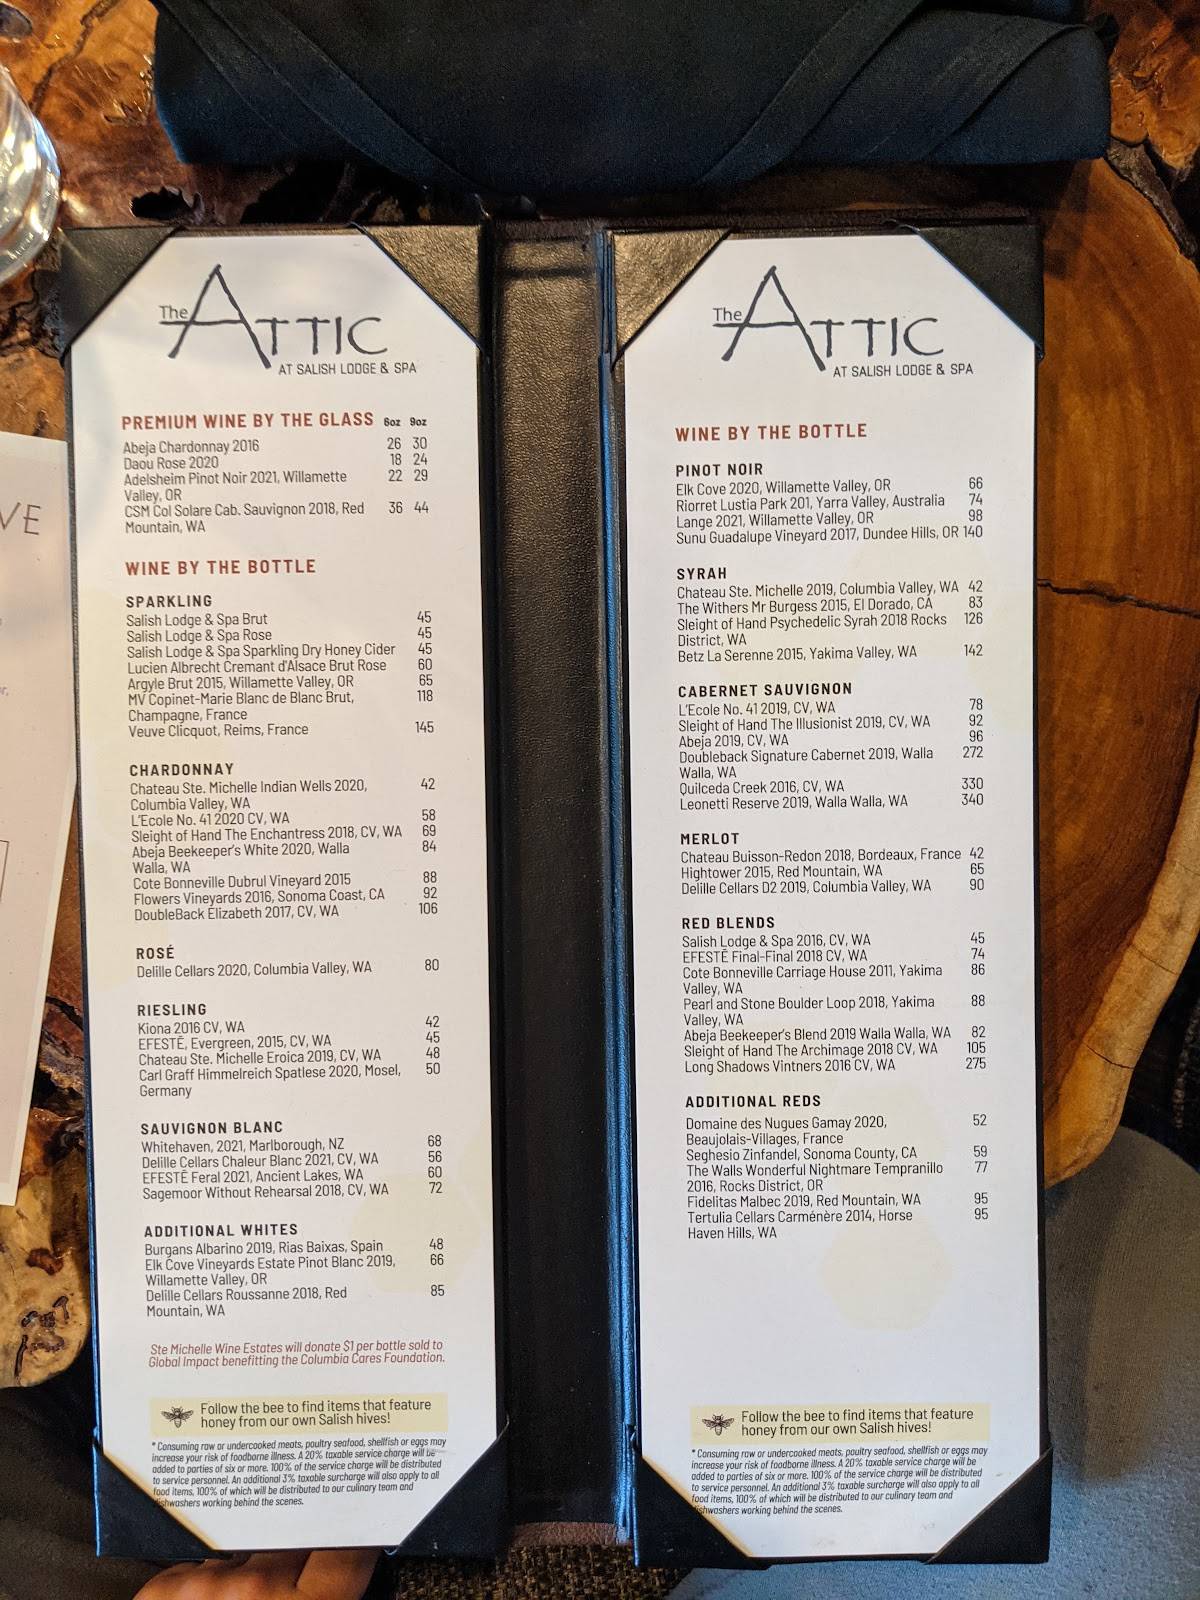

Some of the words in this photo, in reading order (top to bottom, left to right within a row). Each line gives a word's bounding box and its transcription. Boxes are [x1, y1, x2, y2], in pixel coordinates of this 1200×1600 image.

[159, 305, 188, 320] The
[713, 307, 742, 321] The
[278, 363, 293, 375] AT
[296, 362, 336, 375] SALISH
[340, 362, 376, 374] LODGE
[379, 361, 389, 374] &
[393, 361, 416, 374] SPA
[832, 365, 847, 378] AT
[851, 364, 891, 377] SALISH
[895, 364, 932, 376] LODGE
[935, 363, 945, 375] &
[950, 363, 973, 375] SPA
[121, 414, 196, 430] PREMIUM
[203, 413, 247, 428] WINE
[252, 413, 274, 428] BY
[280, 412, 312, 427] THE
[318, 411, 373, 427] GLASS
[383, 416, 401, 427] 6oz
[409, 416, 427, 426] 9oz
[675, 426, 720, 442] WINE
[727, 425, 749, 440] BY
[757, 424, 790, 440] THE
[798, 423, 866, 439] BOTTLE
[122, 441, 157, 457] Abeja
[158, 440, 230, 456] Chardonnay
[231, 439, 259, 452] 2016
[386, 437, 401, 450] 26
[410, 437, 427, 450] 30
[675, 464, 719, 477] PINOT
[727, 463, 762, 476] NOIR
[676, 483, 694, 496] Elk
[696, 482, 726, 496] Cove
[728, 481, 762, 496] 2020,
[765, 480, 829, 494] Willamette
[832, 479, 870, 495] Valley,
[874, 478, 890, 491] OR
[968, 477, 983, 489] 66
[125, 561, 170, 576] WINE
[177, 560, 199, 575] BY
[206, 560, 240, 574] THE
[247, 559, 315, 574] BOTTLE
[676, 567, 726, 580] SYRAH
[125, 595, 212, 608] SPARKLING
[678, 602, 699, 615] The
[702, 601, 750, 614] Withers
[751, 601, 766, 613] Mr
[769, 599, 817, 616] Burgess
[819, 599, 850, 614] 2015,
[853, 598, 864, 611] El
[867, 597, 913, 613] Dorado,
[916, 597, 933, 610] CA
[968, 596, 983, 608] 83
[126, 645, 162, 658] Salish
[165, 645, 202, 661] Lodge
[204, 645, 214, 657] &
[216, 644, 240, 660] Spa
[242, 644, 299, 660] Sparkling
[301, 643, 322, 659] Dry
[324, 643, 362, 659] Honey
[364, 642, 396, 655] Cider
[417, 642, 432, 655] 45
[127, 661, 167, 674] Lucien
[169, 661, 221, 674] Albrecht
[223, 660, 275, 673] Cremant
[277, 659, 327, 672] d'Alsace
[328, 659, 355, 672] Brut
[357, 659, 386, 671] Rose
[417, 658, 432, 670] 60
[678, 684, 757, 698] CABERNET
[764, 682, 851, 696] SAUVIGNON
[129, 763, 233, 776] CHARDONNAY
[130, 782, 179, 795] Chateau
[182, 781, 206, 794] Ste.
[208, 781, 257, 794] Michelle
[260, 780, 296, 793] Indian
[299, 779, 331, 792] Wells
[334, 779, 367, 794] 2020,
[420, 778, 435, 790] 42
[679, 781, 729, 797] Quilceda
[732, 781, 767, 794] Creek
[769, 780, 799, 795] 2016,
[802, 780, 821, 795] CV,
[824, 779, 844, 792] WA
[961, 778, 983, 790] 330
[130, 797, 186, 811] Columbia
[188, 797, 228, 813] Valley,
[229, 796, 250, 809] WA
[680, 833, 739, 845] MERLOT
[681, 917, 710, 929] RED
[716, 916, 774, 929] BLENDS
[136, 944, 174, 960] ROSÉ
[136, 965, 171, 978] Delille
[174, 964, 214, 977] Cellars
[217, 963, 250, 979] 2020,
[253, 962, 309, 975] Columbia
[311, 961, 349, 977] Valley,
[352, 960, 372, 973] WA
[424, 959, 439, 971] 80
[137, 1003, 206, 1017] RIESLING
[685, 1095, 776, 1108] ADDITIONAL
[782, 1095, 820, 1107] REDS
[140, 1122, 227, 1135] SAUVIGNON
[233, 1121, 282, 1133] BLANC
[686, 1117, 737, 1130] Domaine
[740, 1117, 761, 1129] des
[764, 1116, 809, 1132] Nugues
[811, 1116, 851, 1132] Gamay
[854, 1116, 886, 1130] 2020,
[972, 1114, 987, 1126] 52
[144, 1224, 234, 1238] ADDITIONAL
[240, 1223, 297, 1236] WHITES
[144, 1243, 193, 1259] Burgans
[195, 1242, 243, 1255] Albarino
[245, 1241, 275, 1256] 2019,
[278, 1241, 303, 1254] Rias
[306, 1240, 347, 1255] Baixas,
[350, 1239, 383, 1255] Spain
[429, 1238, 443, 1250] 48
[200, 1401, 238, 1415] Follow
[241, 1401, 260, 1414] the
[261, 1400, 284, 1413] bee
[285, 1400, 299, 1413] to
[300, 1400, 324, 1413] find
[327, 1399, 360, 1412] items
[362, 1398, 386, 1411] that
[389, 1397, 431, 1411] feature
[200, 1415, 236, 1430] honey
[237, 1414, 268, 1428] from
[269, 1416, 290, 1427] our
[291, 1415, 316, 1426] own
[319, 1412, 353, 1426] Salish
[355, 1411, 390, 1425] hives!
[690, 1472, 715, 1482] added
[716, 1472, 724, 1481] to
[725, 1471, 754, 1483] parties
[754, 1471, 764, 1480] of
[764, 1471, 776, 1480] six
[776, 1472, 786, 1480] or
[786, 1472, 810, 1480] more.
[810, 1470, 832, 1480] 100%
[833, 1470, 843, 1479] of
[843, 1469, 857, 1479] the
[856, 1469, 885, 1479] service
[886, 1468, 913, 1480] charge
[914, 1468, 928, 1478] will
[928, 1468, 939, 1478] be
[940, 1467, 982, 1477] distributed
